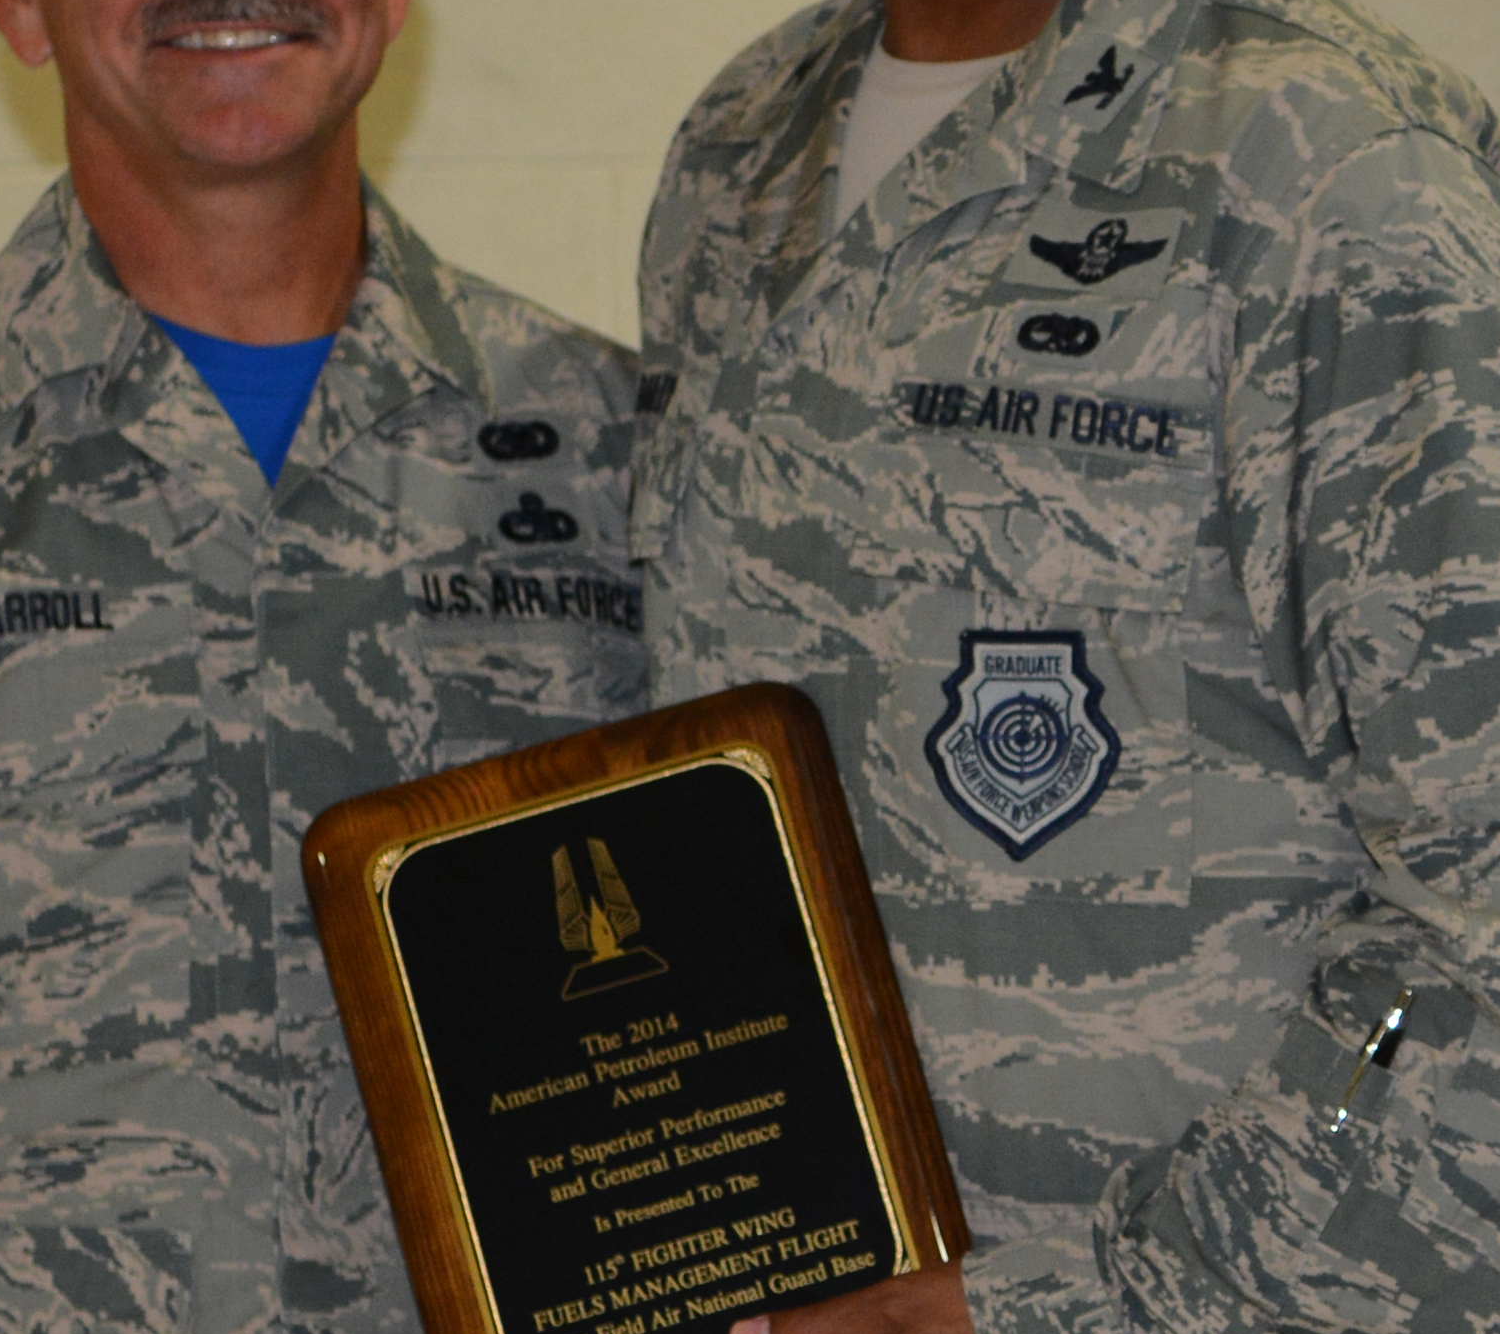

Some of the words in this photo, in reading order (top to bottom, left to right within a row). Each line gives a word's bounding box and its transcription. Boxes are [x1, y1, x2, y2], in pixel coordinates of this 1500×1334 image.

[977, 386, 1039, 437] AIR
[1049, 394, 1181, 457] FORCE
[422, 572, 482, 616] U.S.
[491, 573, 547, 617] AIR
[556, 575, 644, 633] FORCE
[984, 654, 1063, 675] GRADUATE
[489, 1071, 590, 1114] American
[593, 1039, 700, 1083] Petroleum
[703, 1013, 789, 1051] Institute
[580, 1031, 622, 1056] The
[627, 1012, 680, 1044] 2014
[612, 1070, 682, 1108] Award
[527, 1154, 564, 1178] For
[570, 1128, 654, 1166] Superior
[659, 1090, 786, 1139] Performance
[550, 1175, 587, 1203] and
[591, 1151, 670, 1190] General
[673, 1121, 782, 1167] Excellence
[594, 1216, 612, 1233] Is
[614, 1189, 695, 1227] Presented
[697, 1183, 723, 1202] To
[724, 1173, 760, 1194] The
[630, 1226, 729, 1272] FIGHTER
[731, 1206, 796, 1241] WING
[532, 1294, 606, 1333] FUELS
[609, 1245, 775, 1310] MANAGEMENT
[778, 1219, 860, 1262] FLIGHT
[651, 1307, 681, 1331] Air
[685, 1284, 766, 1320] National
[768, 1261, 827, 1295] Guard
[831, 1250, 876, 1277] Base
